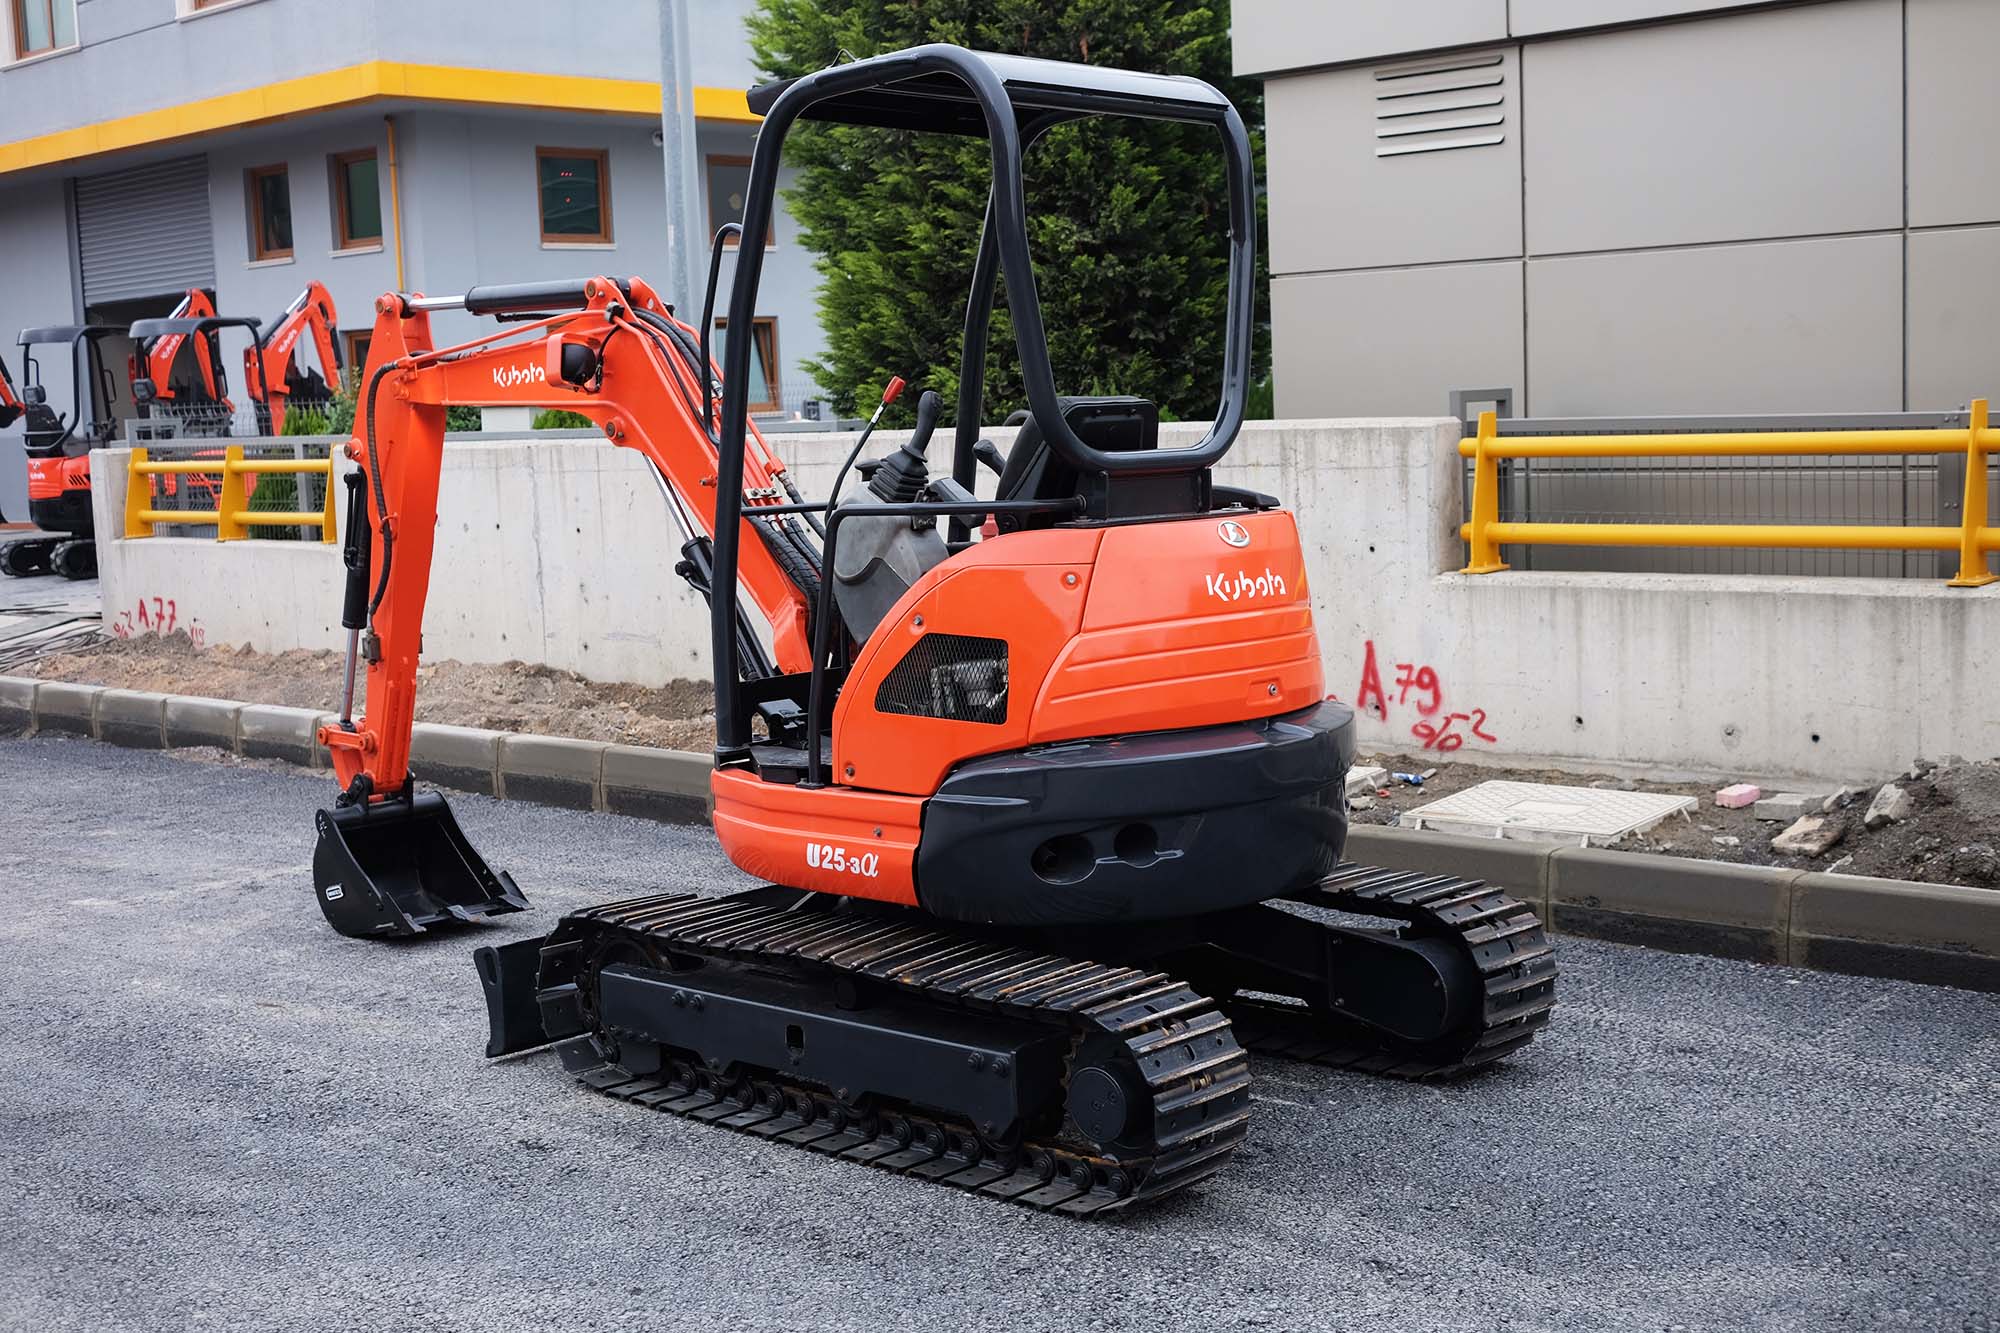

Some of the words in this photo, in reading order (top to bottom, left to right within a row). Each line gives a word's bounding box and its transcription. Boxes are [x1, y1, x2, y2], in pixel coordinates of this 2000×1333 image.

[493, 362, 545, 388] Kubota
[1205, 567, 1287, 602] Kubota
[138, 597, 177, 634] A.77
[1357, 640, 1443, 722] A.79
